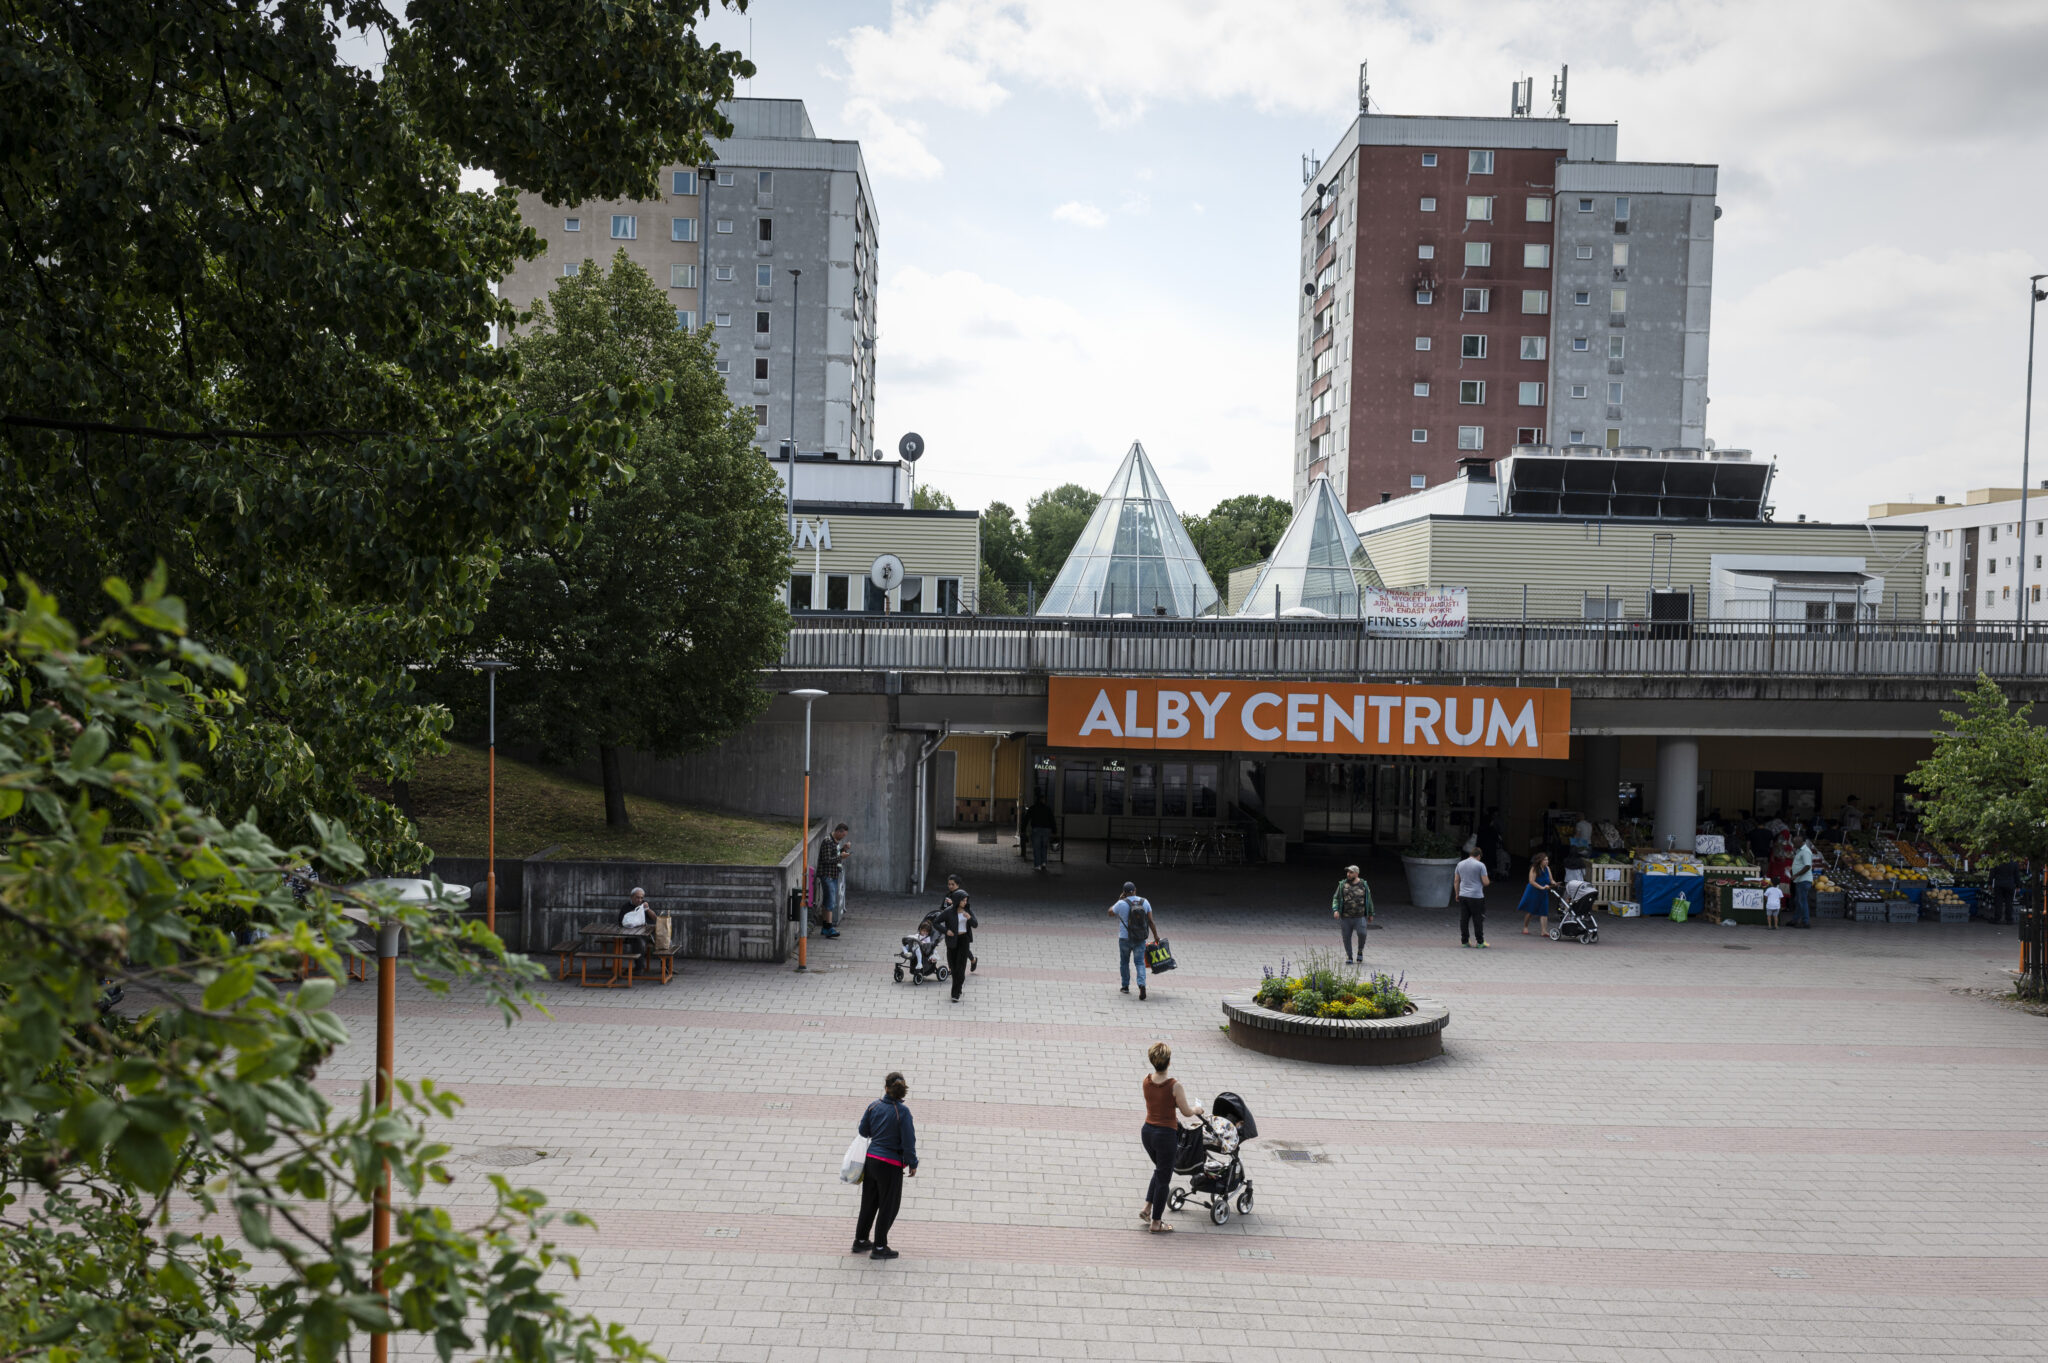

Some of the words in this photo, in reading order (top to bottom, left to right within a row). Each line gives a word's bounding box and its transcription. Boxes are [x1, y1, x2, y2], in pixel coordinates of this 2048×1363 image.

[1367, 616, 1417, 628] FITNESS
[1078, 688, 1232, 739] ALBY
[1240, 692, 1538, 748] CENTRUM
[1149, 947, 1171, 964] XXL
